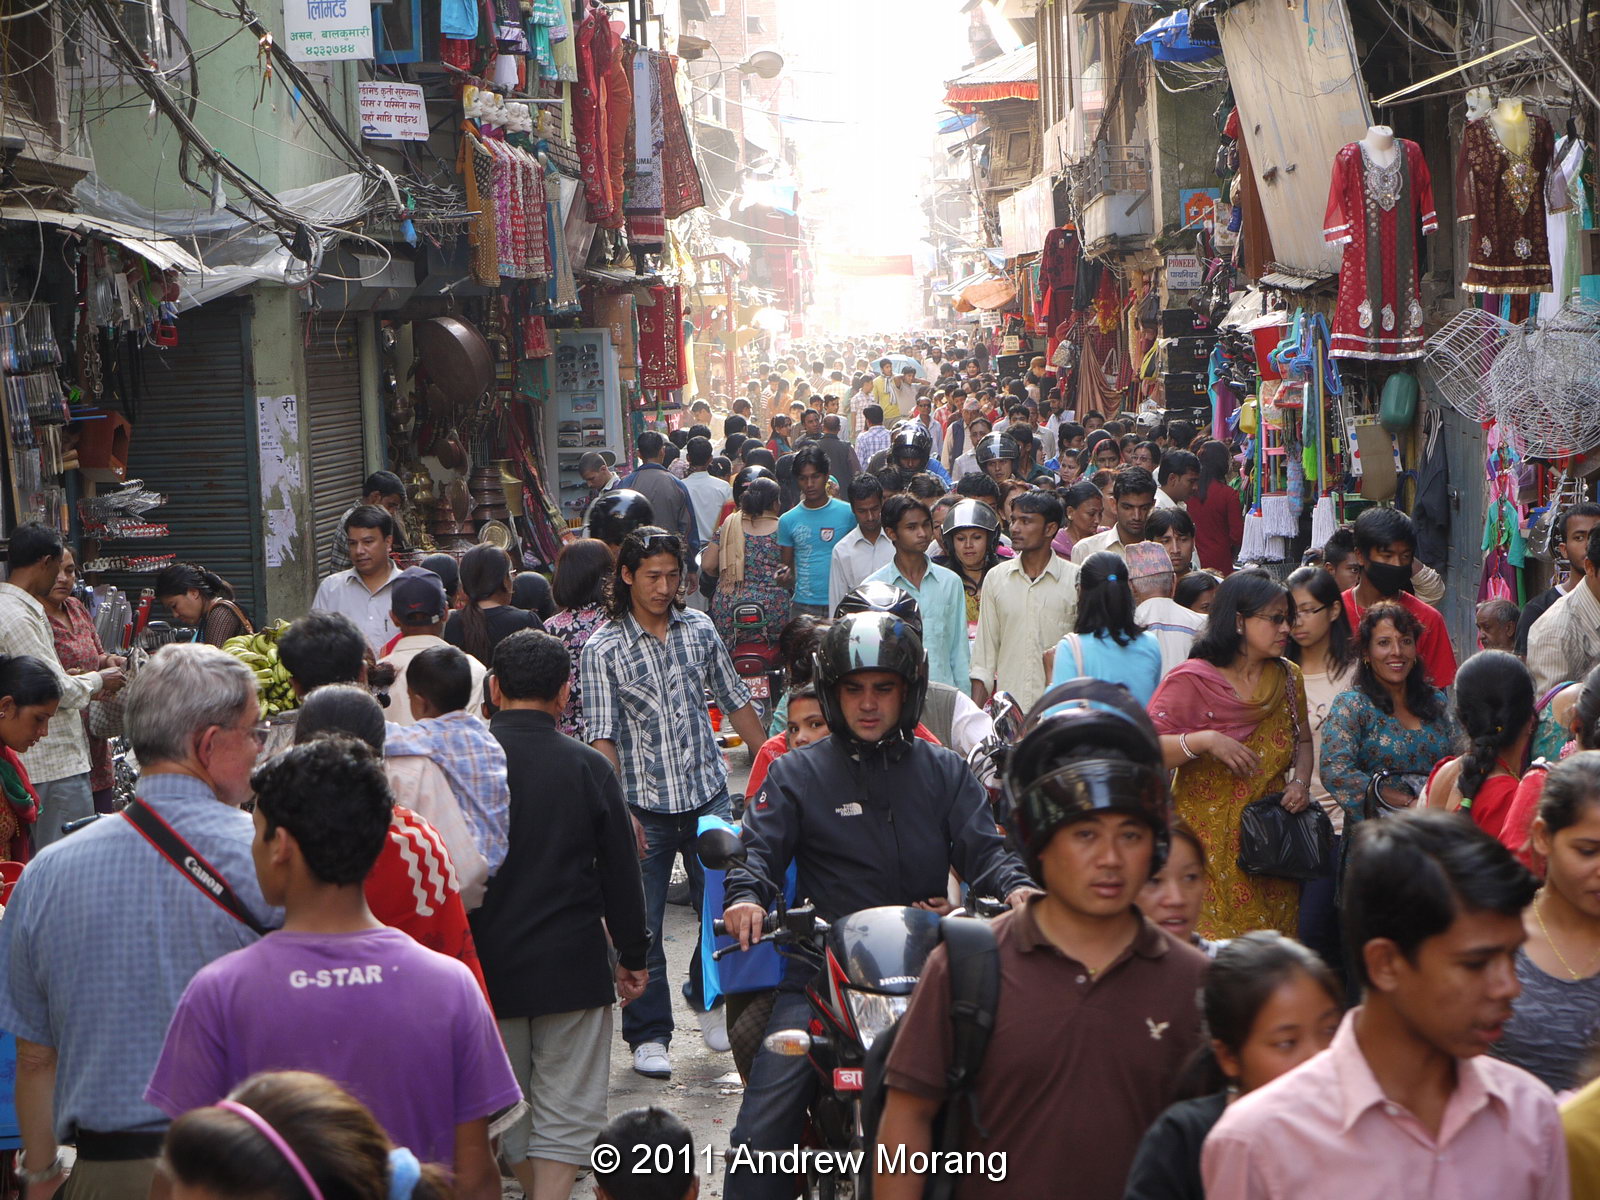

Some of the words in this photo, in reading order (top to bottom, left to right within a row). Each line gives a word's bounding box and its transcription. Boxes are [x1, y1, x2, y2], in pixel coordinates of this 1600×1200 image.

[1168, 259, 1196, 268] PIONEER
[184, 856, 224, 895] Canon
[289, 964, 383, 988] G-STAR
